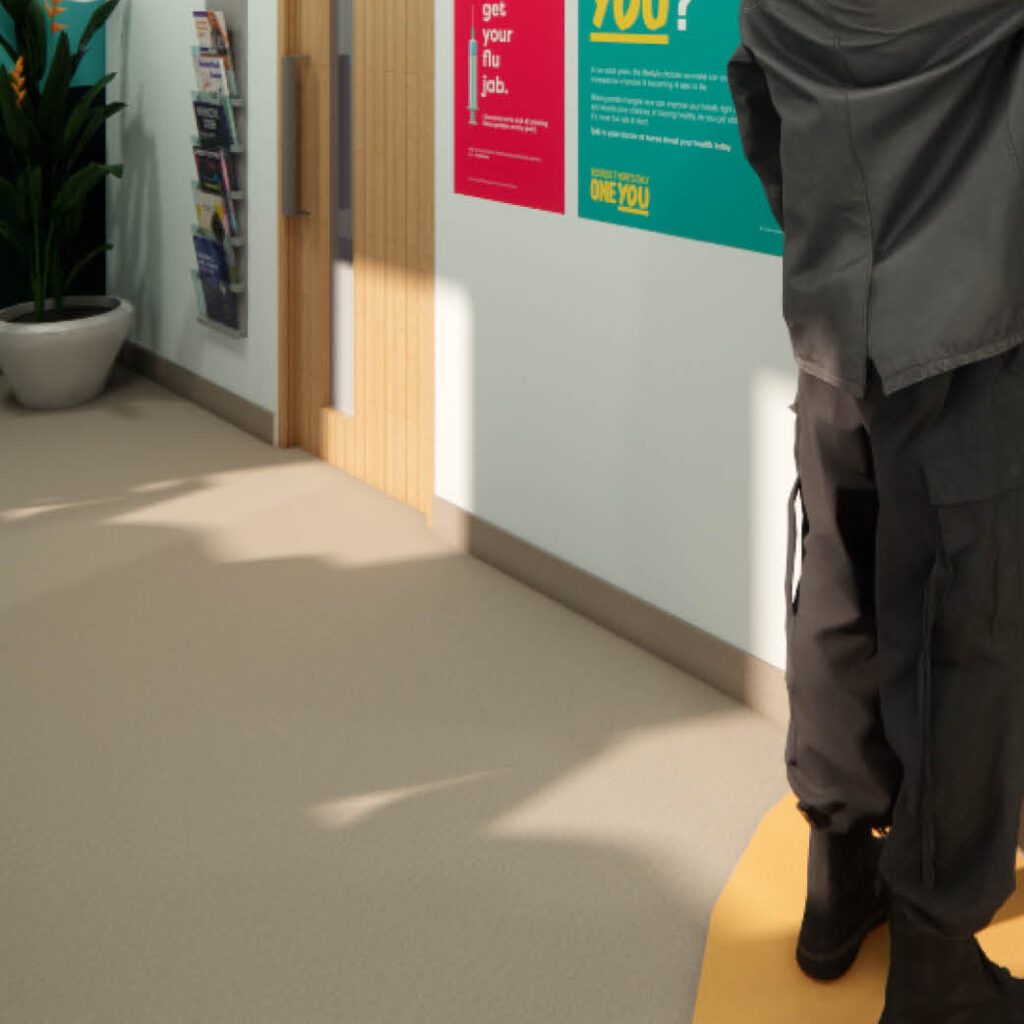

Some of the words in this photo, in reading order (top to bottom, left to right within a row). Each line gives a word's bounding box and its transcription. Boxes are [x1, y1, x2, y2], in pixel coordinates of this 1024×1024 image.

[482, 0, 507, 23] get
[482, 28, 514, 48] your
[482, 49, 501, 69] flu
[480, 74, 509, 98] jab.
[590, 178, 616, 204] ONE
[617, 182, 650, 210] YOU
